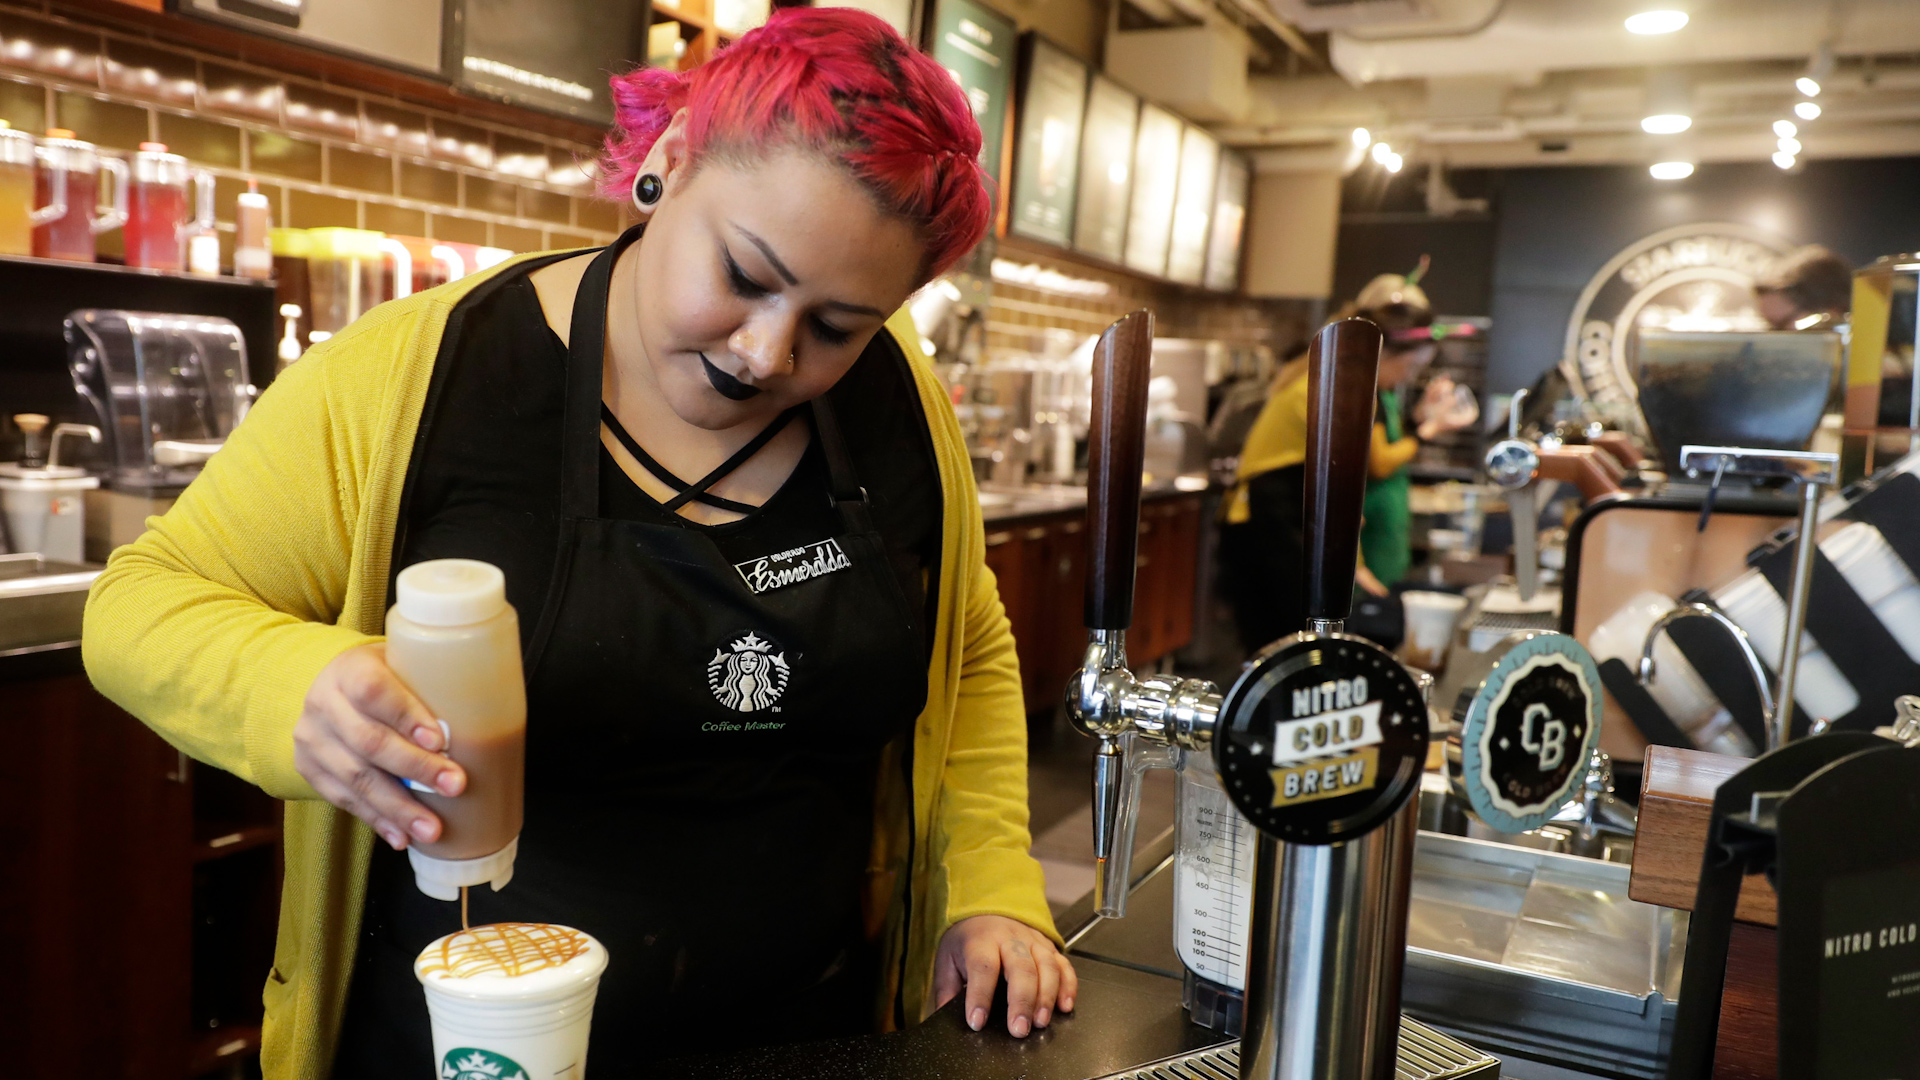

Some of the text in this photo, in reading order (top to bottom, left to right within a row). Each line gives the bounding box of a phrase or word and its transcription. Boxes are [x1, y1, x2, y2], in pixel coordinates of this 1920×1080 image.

[747, 543, 851, 592] Esmeralda
[1292, 675, 1369, 716] NITRO
[701, 721, 787, 732] Coffee Master
[1292, 714, 1364, 752] COLD
[1283, 758, 1365, 798] BREW
[1199, 807, 1213, 815] 900
[1199, 830, 1212, 839] 750
[1196, 855, 1210, 864] 600
[1195, 882, 1209, 890] 450
[1194, 908, 1207, 918] 300
[1192, 928, 1206, 937] 200
[1193, 938, 1206, 947] 150
[1824, 922, 1917, 959] NITRO COLD
[1192, 948, 1206, 957] 100
[1196, 963, 1205, 971] 50
